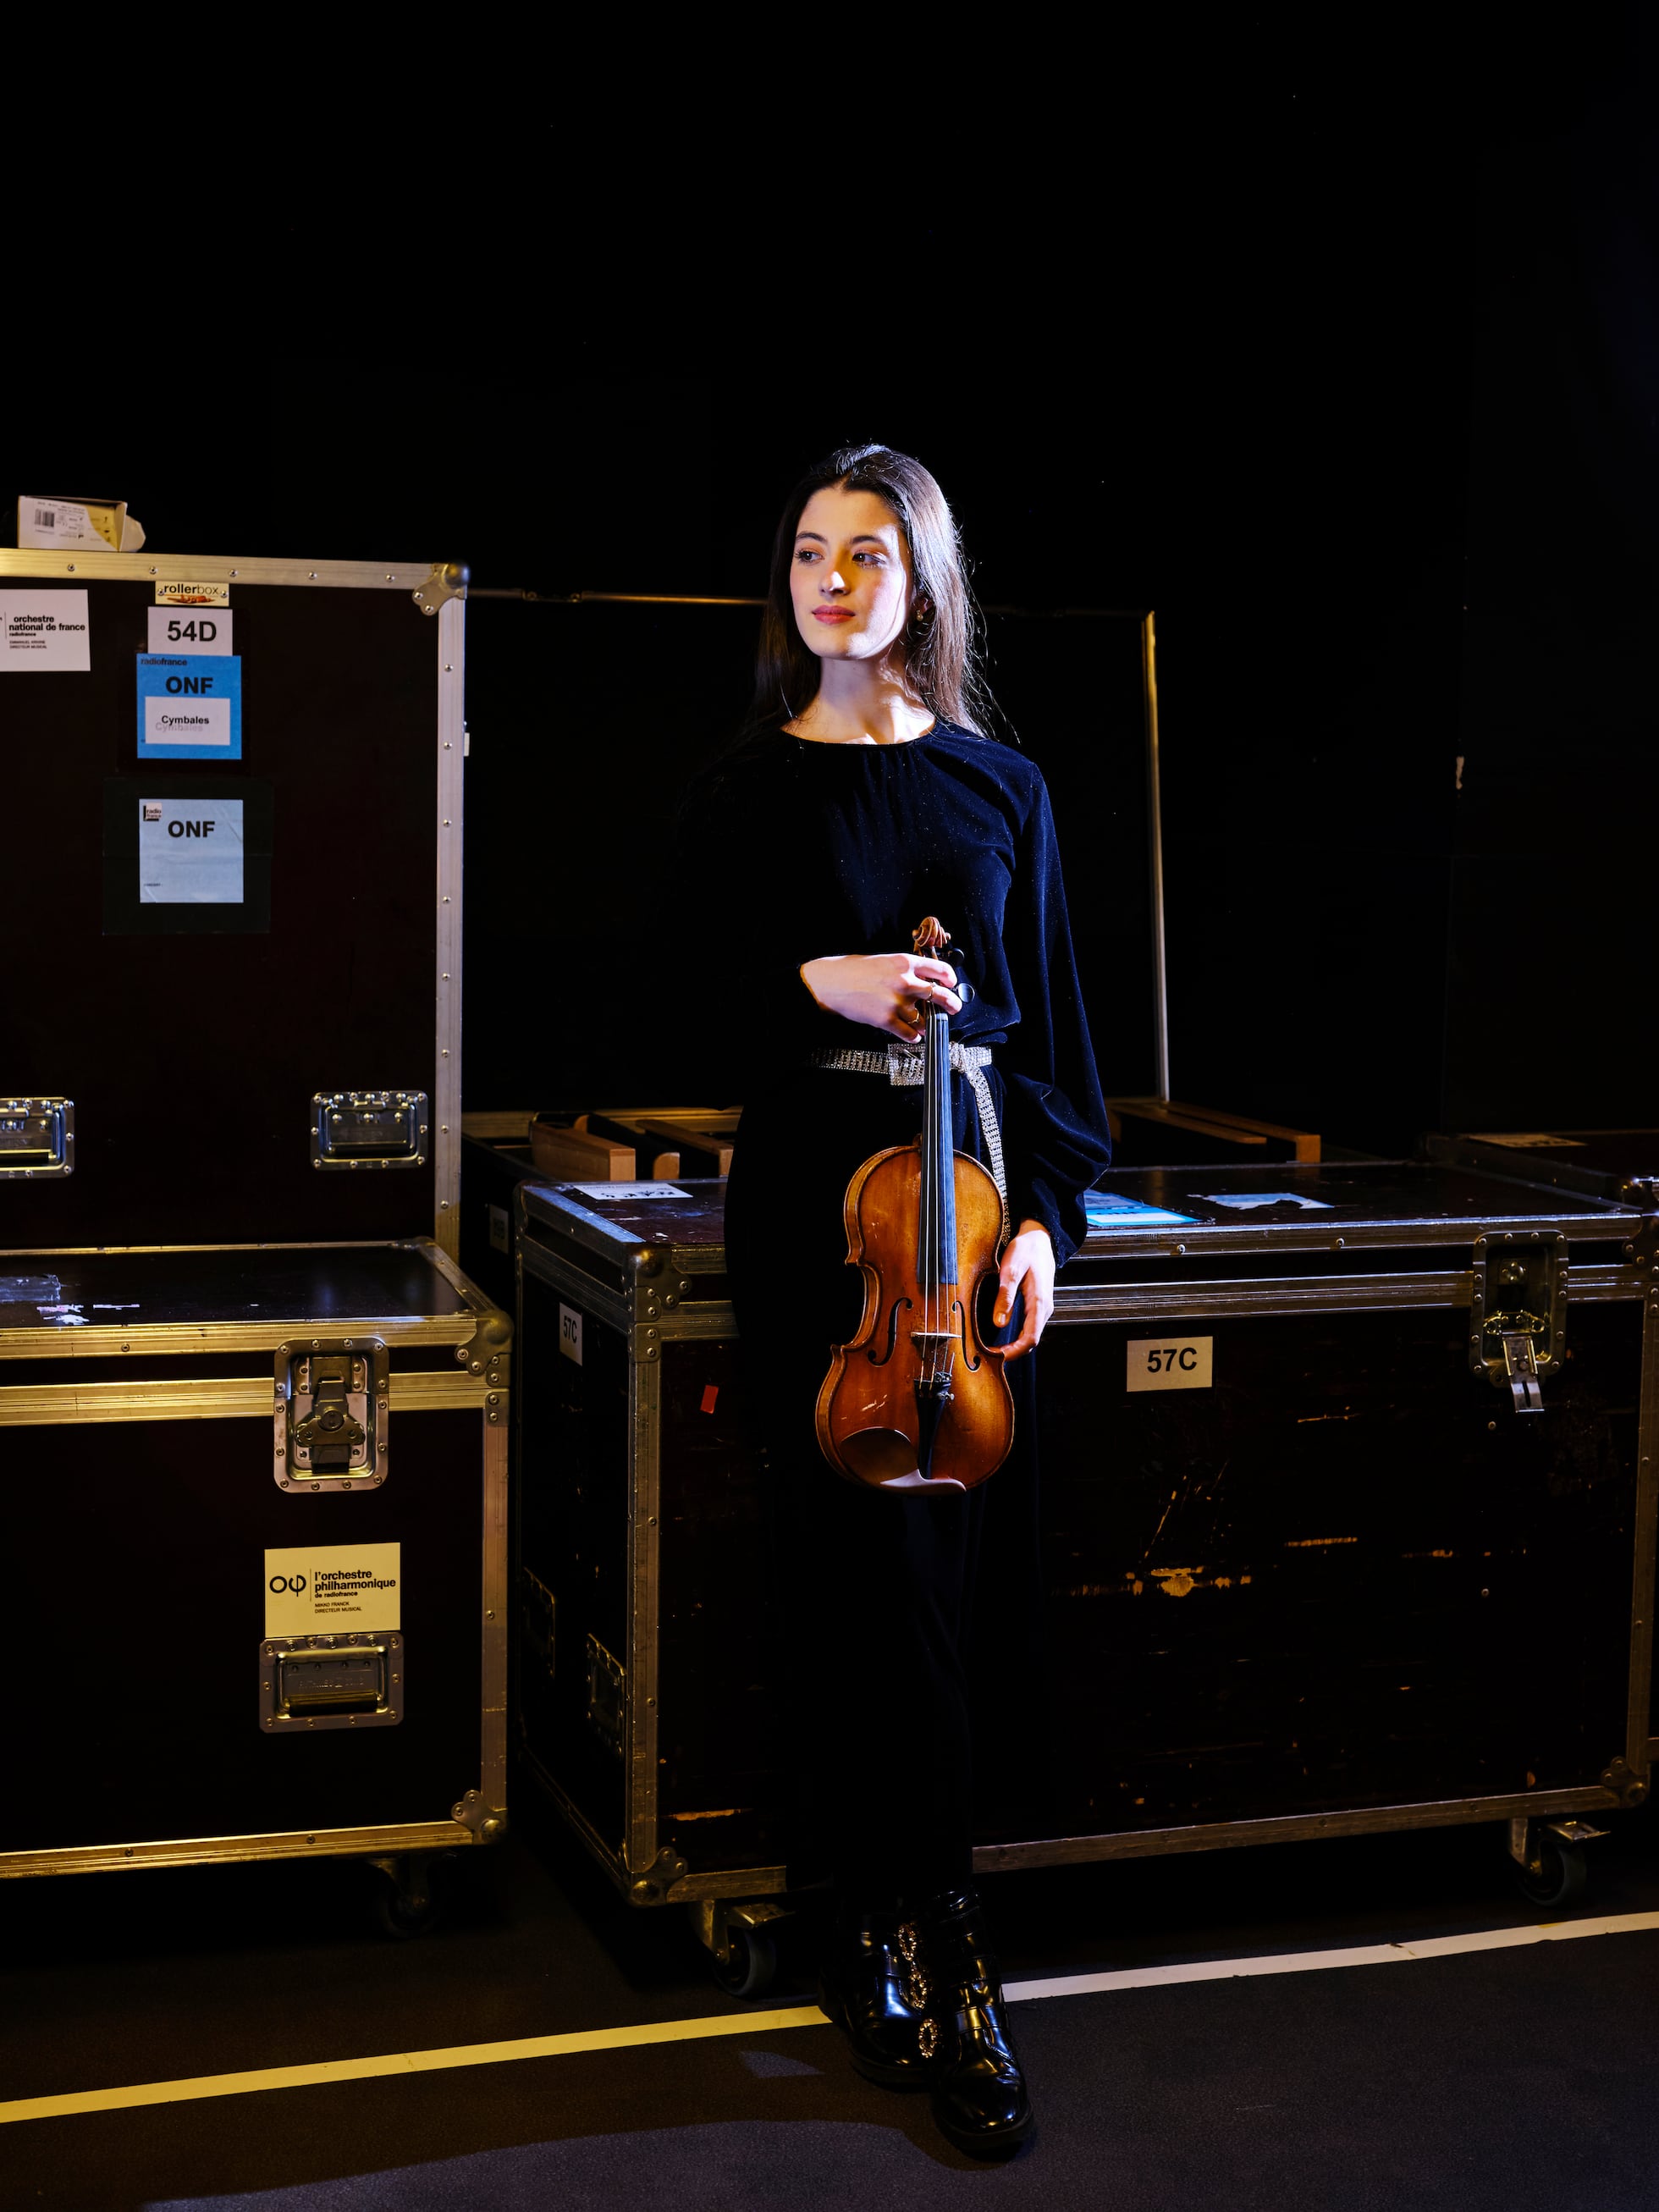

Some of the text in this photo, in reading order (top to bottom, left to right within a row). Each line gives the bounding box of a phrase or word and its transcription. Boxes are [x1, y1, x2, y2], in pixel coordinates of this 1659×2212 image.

[164, 583, 218, 595] rollerbox
[14, 615, 54, 623] orchestre
[168, 621, 217, 642] 54D
[165, 676, 213, 694] ONF
[162, 715, 210, 725] Cymbales
[168, 820, 215, 838] ONF
[563, 1316, 577, 1343] 57C
[1147, 1348, 1197, 1373] 57C
[314, 1579, 396, 1593] philharmonique
